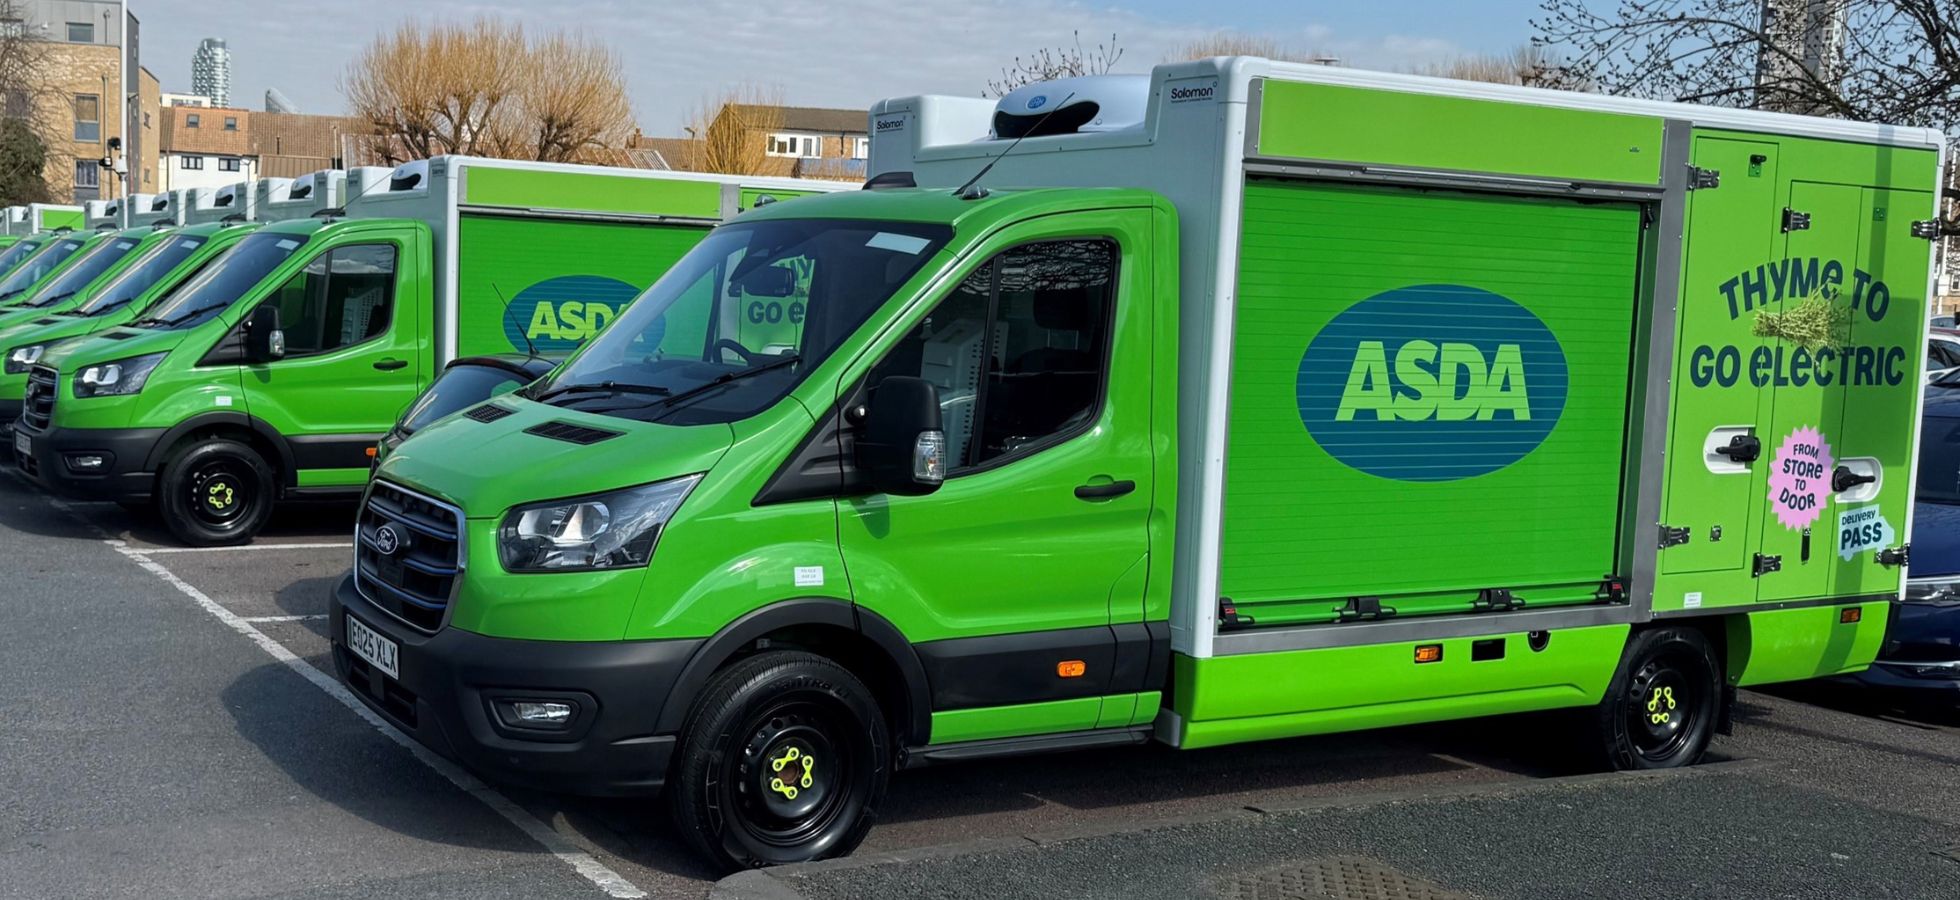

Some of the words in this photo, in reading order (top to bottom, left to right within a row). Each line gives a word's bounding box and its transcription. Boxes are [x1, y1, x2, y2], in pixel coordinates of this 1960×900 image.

[1171, 87, 1213, 99] Solomon
[876, 119, 904, 130] Solomon
[1852, 268, 1890, 322] TO
[527, 301, 640, 341] ASD
[747, 301, 783, 324] GO
[1690, 344, 1741, 388] GO
[1334, 339, 1531, 421] ASDA
[1793, 443, 1819, 459] FROM
[1795, 479, 1806, 491] TO
[1779, 487, 1816, 511] DOOR
[377, 528, 393, 551] Ford
[1841, 521, 1882, 550] PASS
[376, 637, 396, 673] XLX
